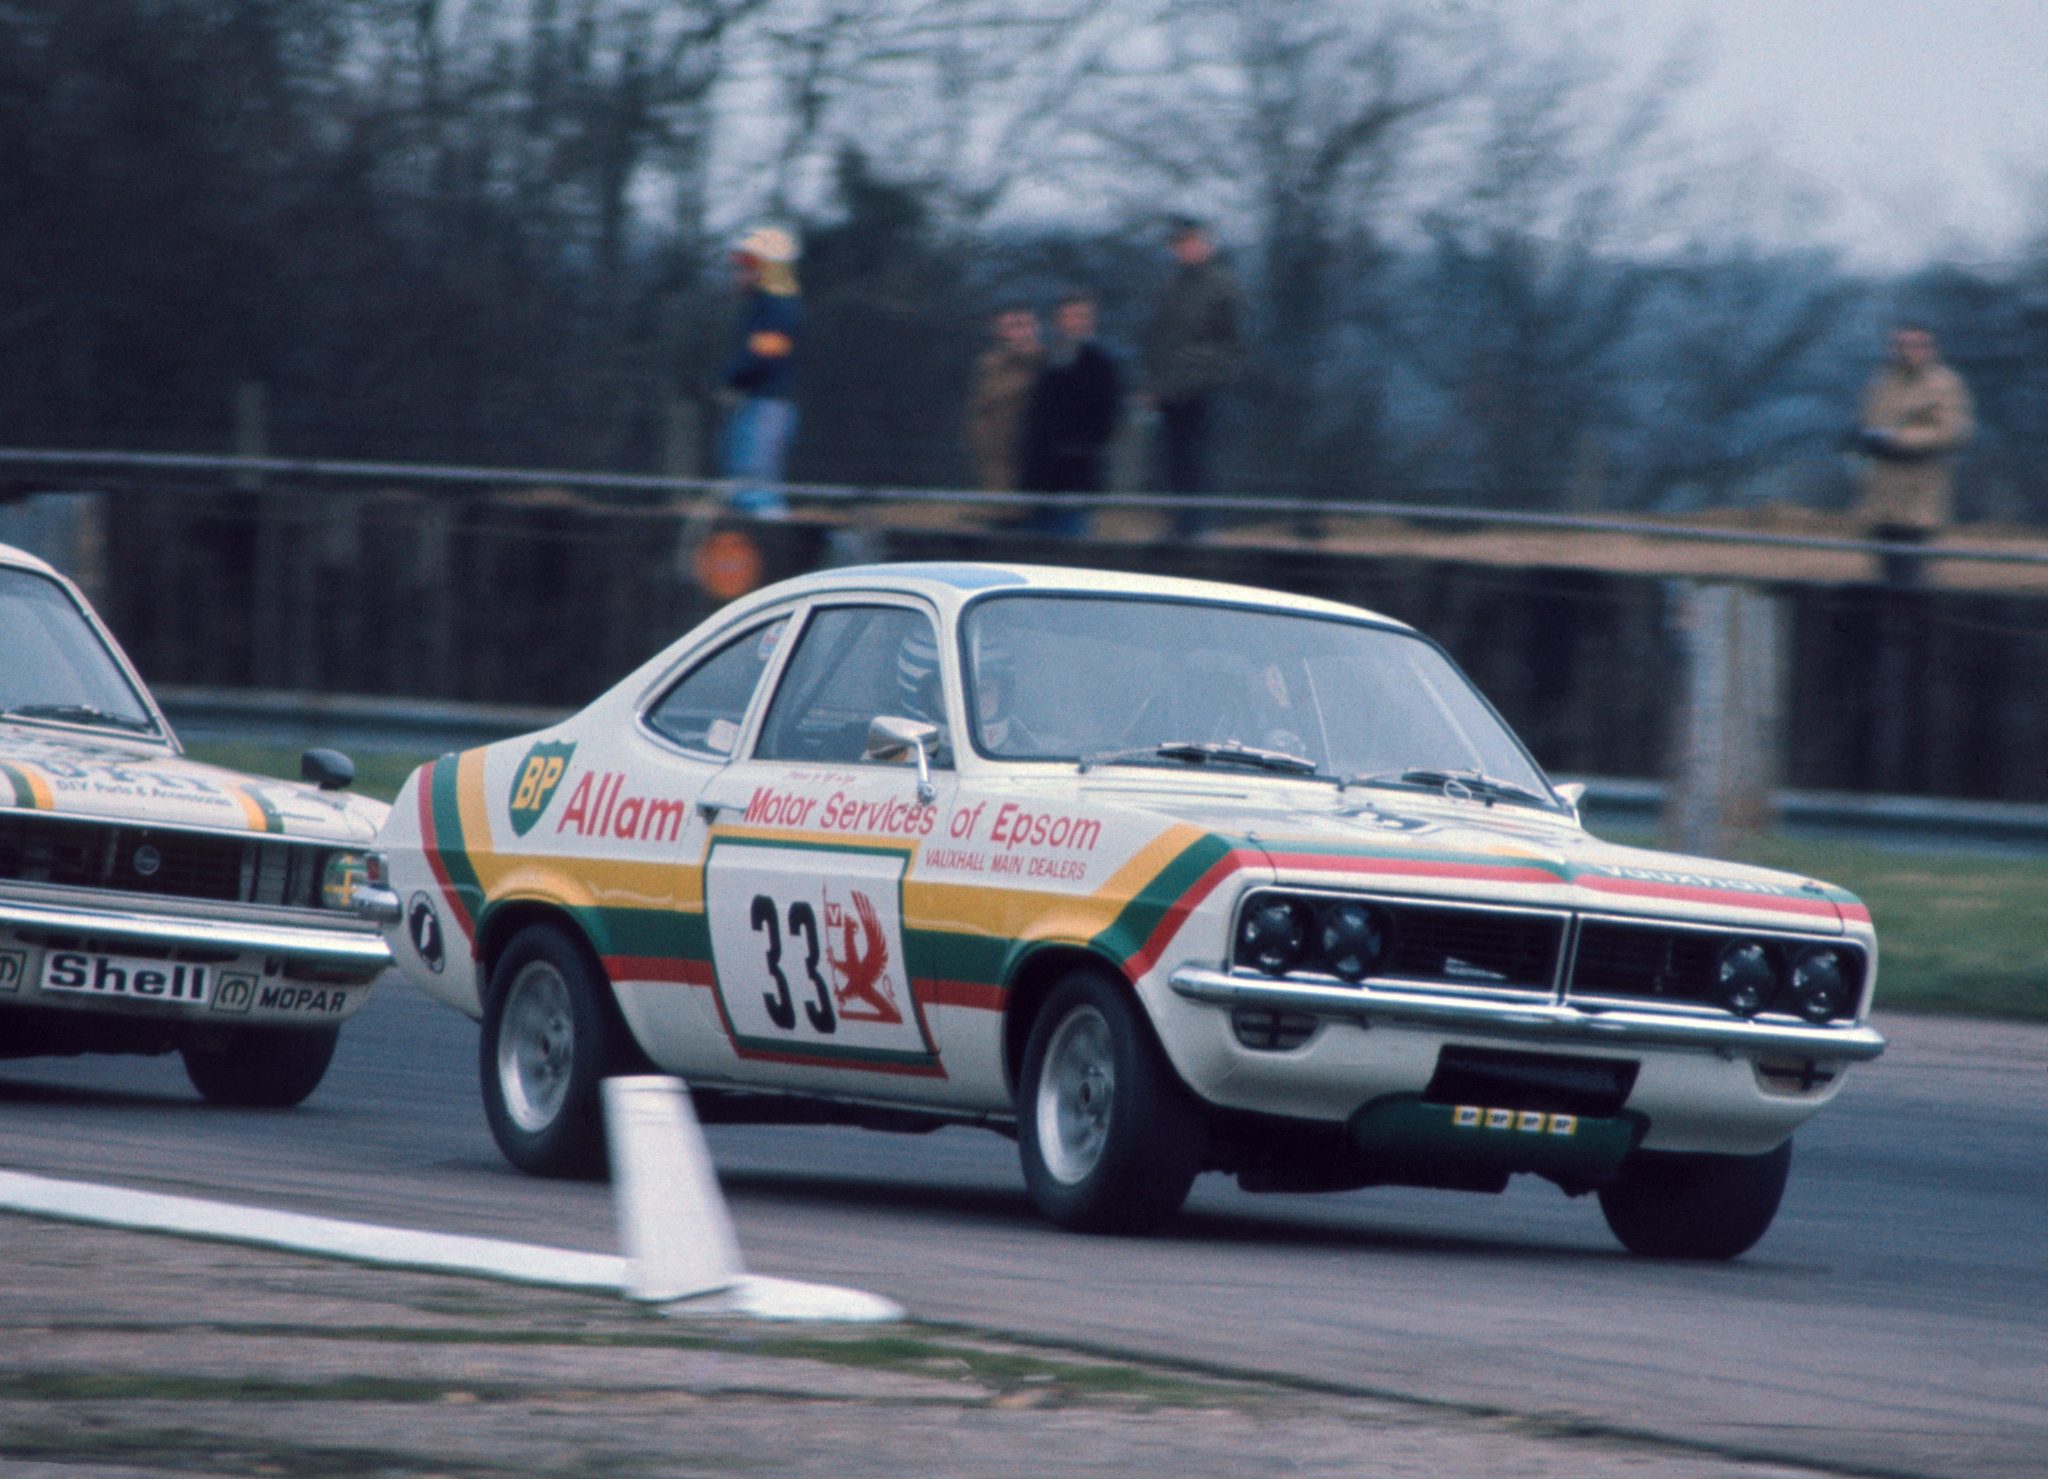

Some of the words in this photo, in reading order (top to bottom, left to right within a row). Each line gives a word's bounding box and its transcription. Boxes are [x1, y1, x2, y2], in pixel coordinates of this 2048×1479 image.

[512, 756, 565, 810] BP
[556, 770, 685, 842] Allam
[744, 786, 817, 827] Motor
[820, 790, 938, 836] Services
[950, 800, 987, 841] of
[989, 802, 1102, 851] Epsom
[926, 848, 985, 872] VAUXHALL
[990, 854, 1025, 875] MAIN
[1027, 857, 1088, 881] DEALERS
[50, 952, 205, 999] Shell
[751, 894, 837, 1035] 33
[259, 985, 347, 1013] MOPAR
